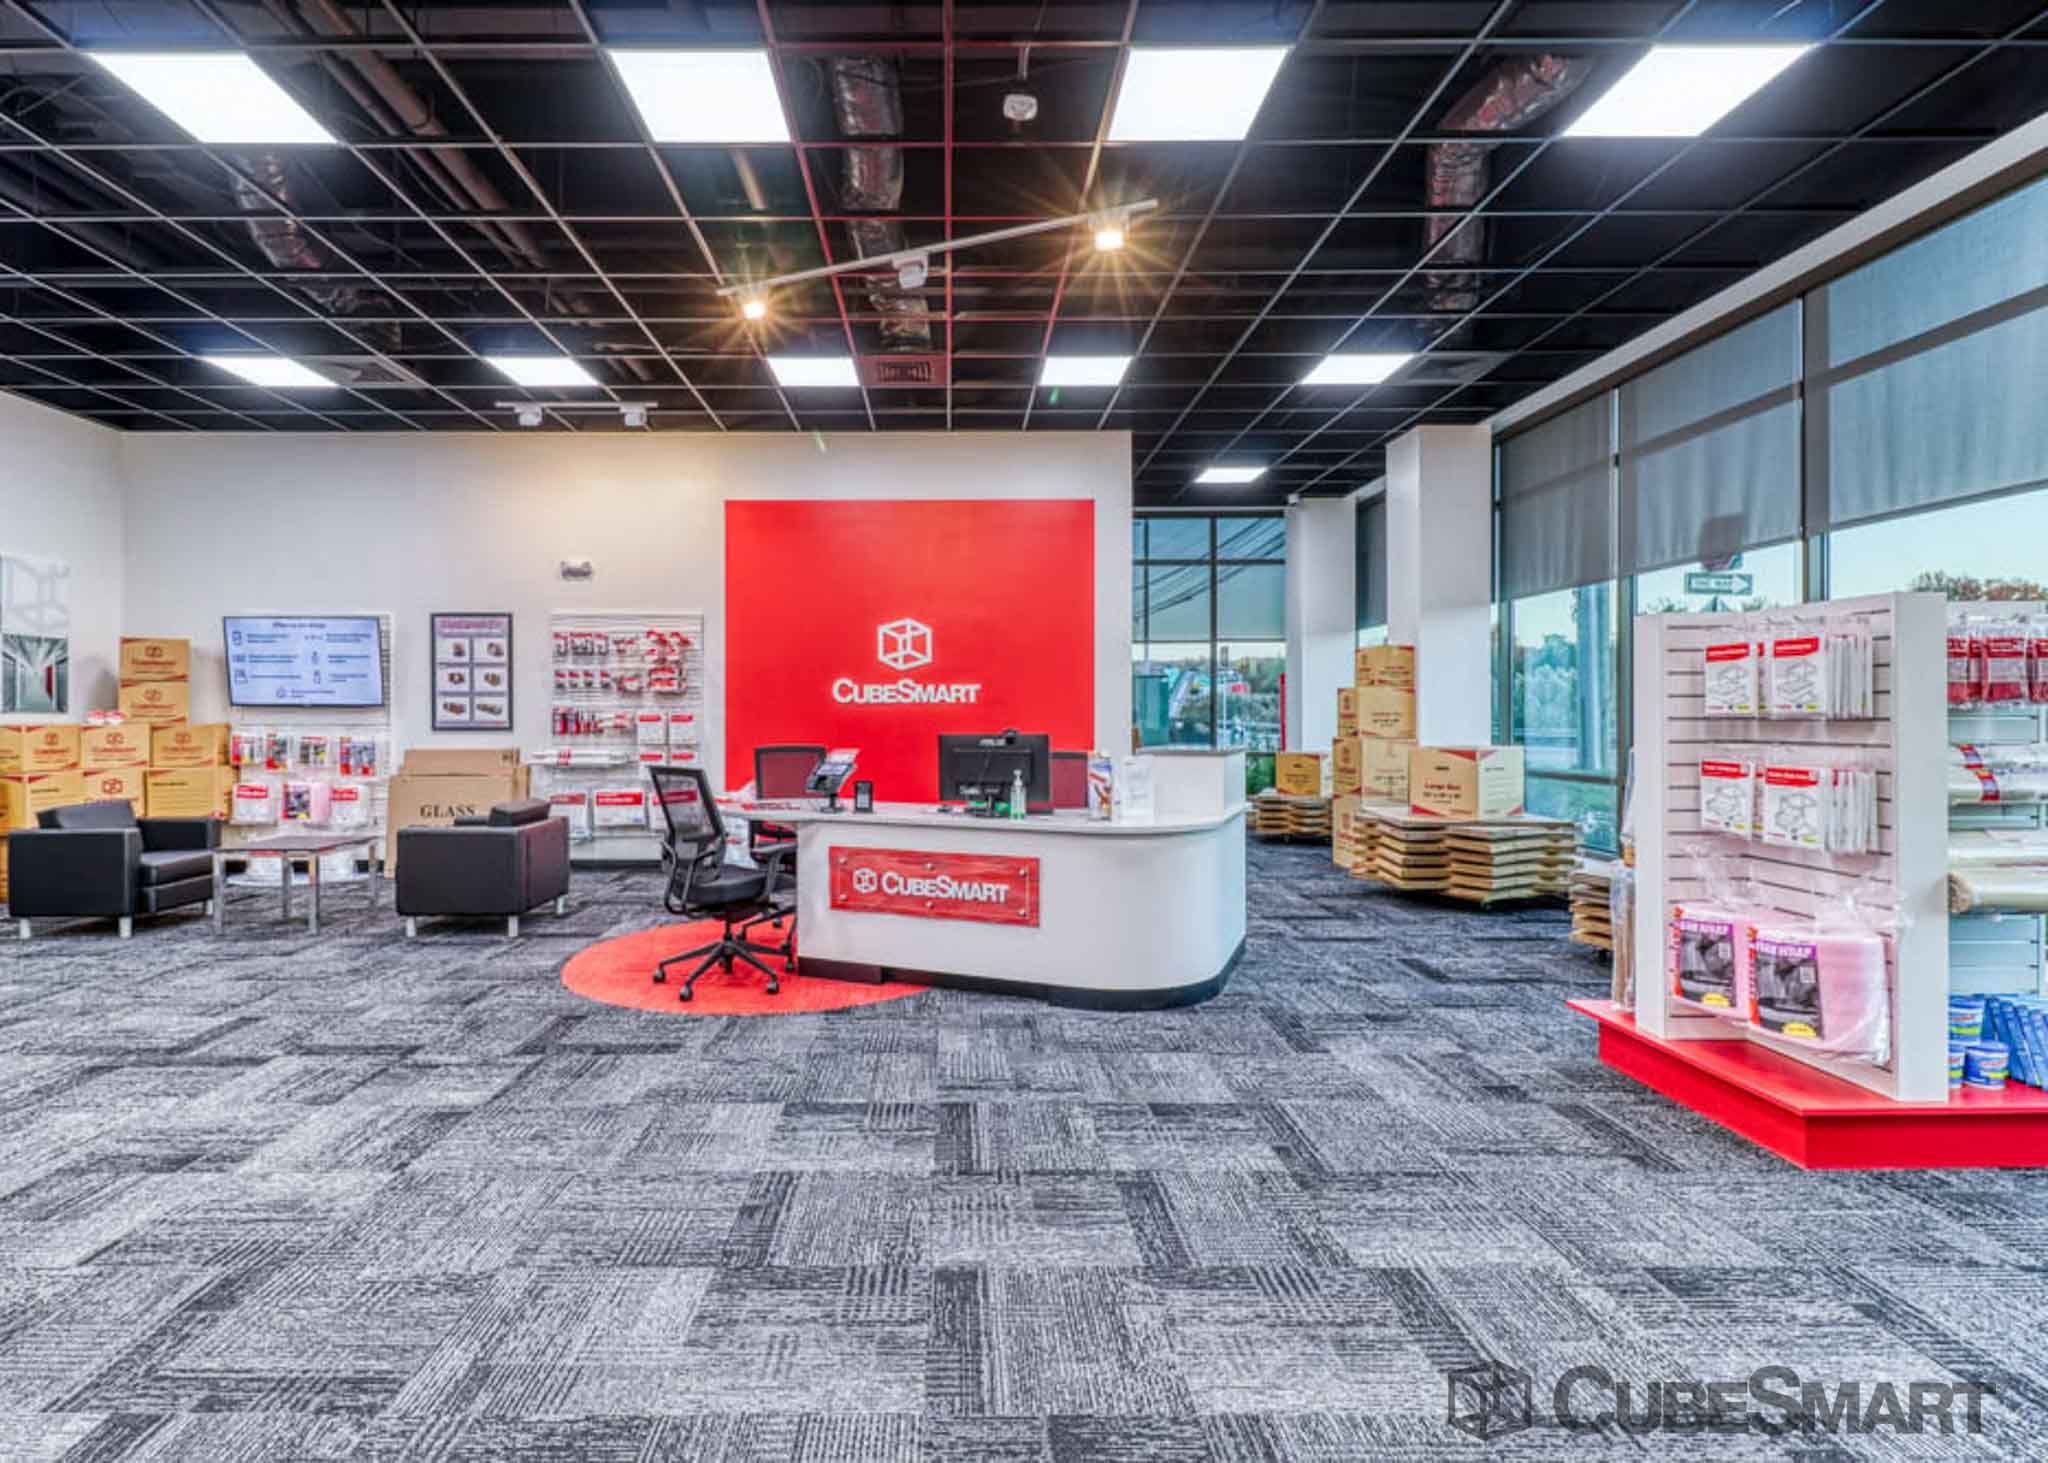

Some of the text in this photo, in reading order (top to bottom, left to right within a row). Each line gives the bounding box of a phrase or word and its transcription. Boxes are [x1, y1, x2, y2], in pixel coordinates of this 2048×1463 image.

[832, 677, 982, 703] CUBESMART
[420, 804, 476, 818] GLASS
[881, 871, 1010, 904] CUBESMART
